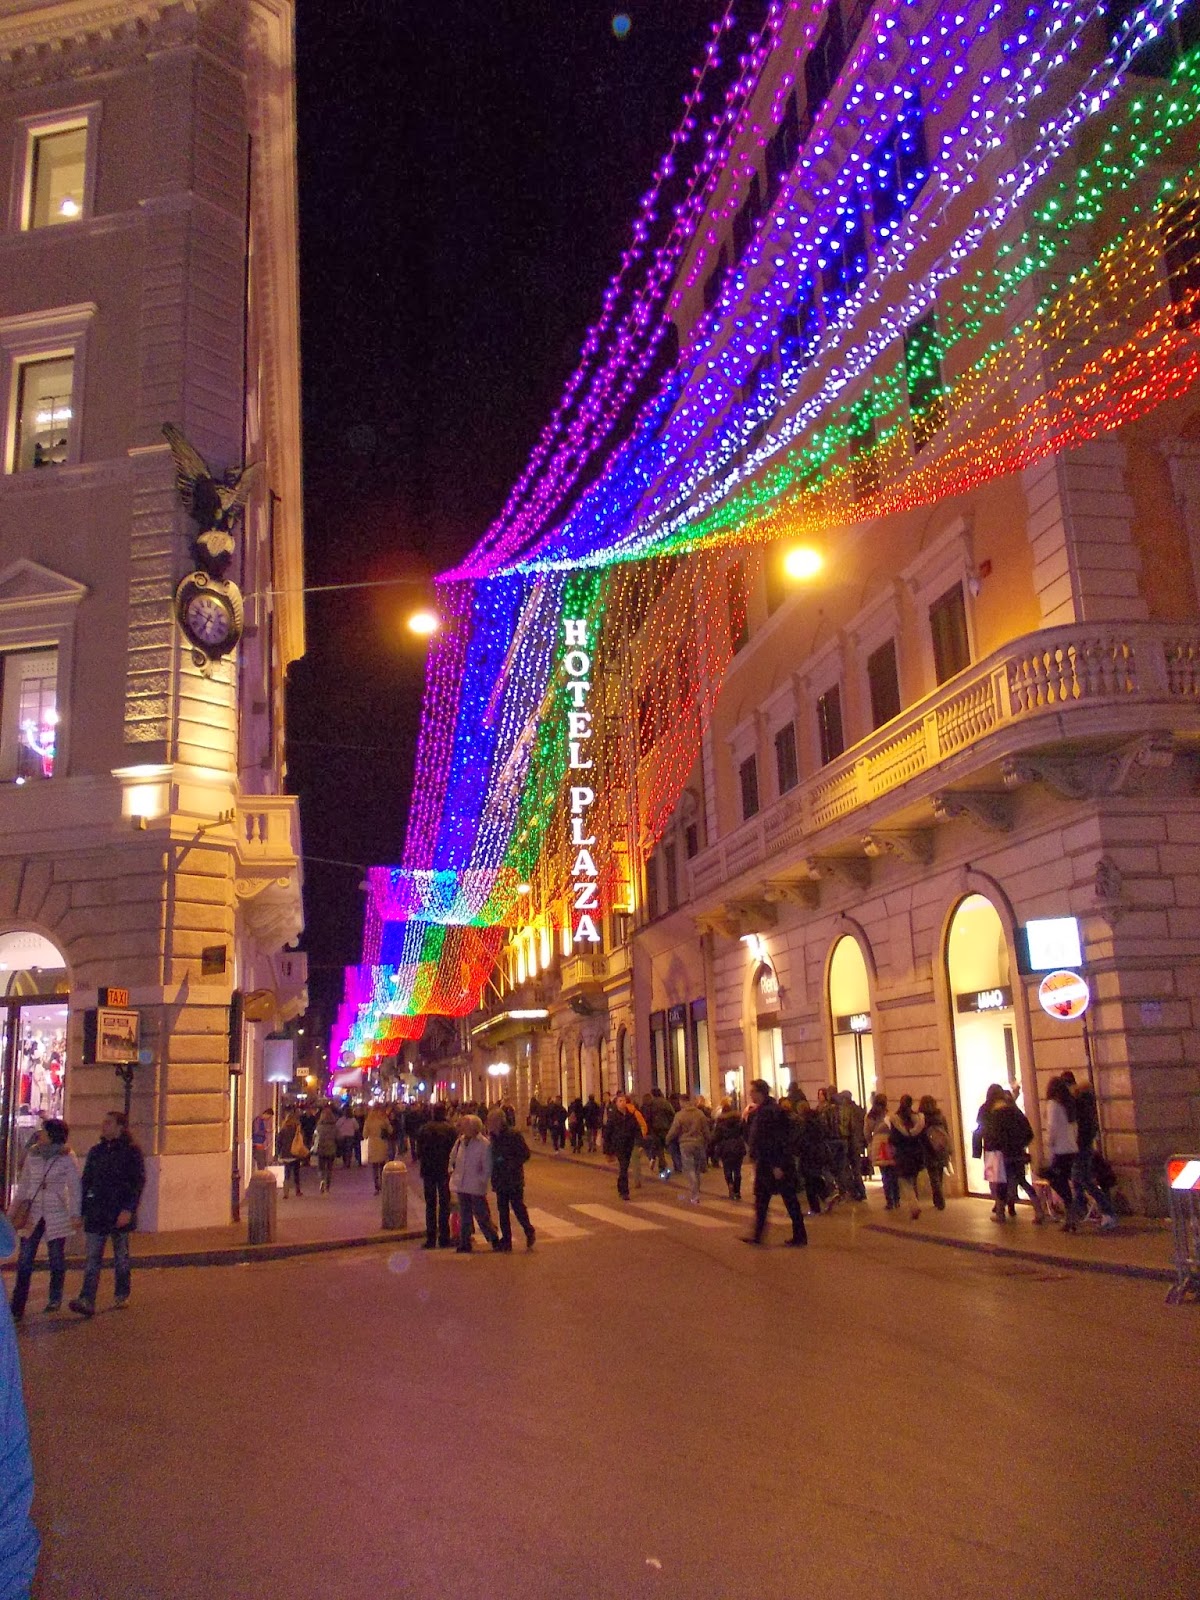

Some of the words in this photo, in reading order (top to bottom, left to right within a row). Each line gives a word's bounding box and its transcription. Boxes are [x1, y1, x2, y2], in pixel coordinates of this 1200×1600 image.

[563, 618, 593, 769] HOTEL
[569, 786, 600, 942] PLAZA
[109, 990, 127, 1005] TAXI
